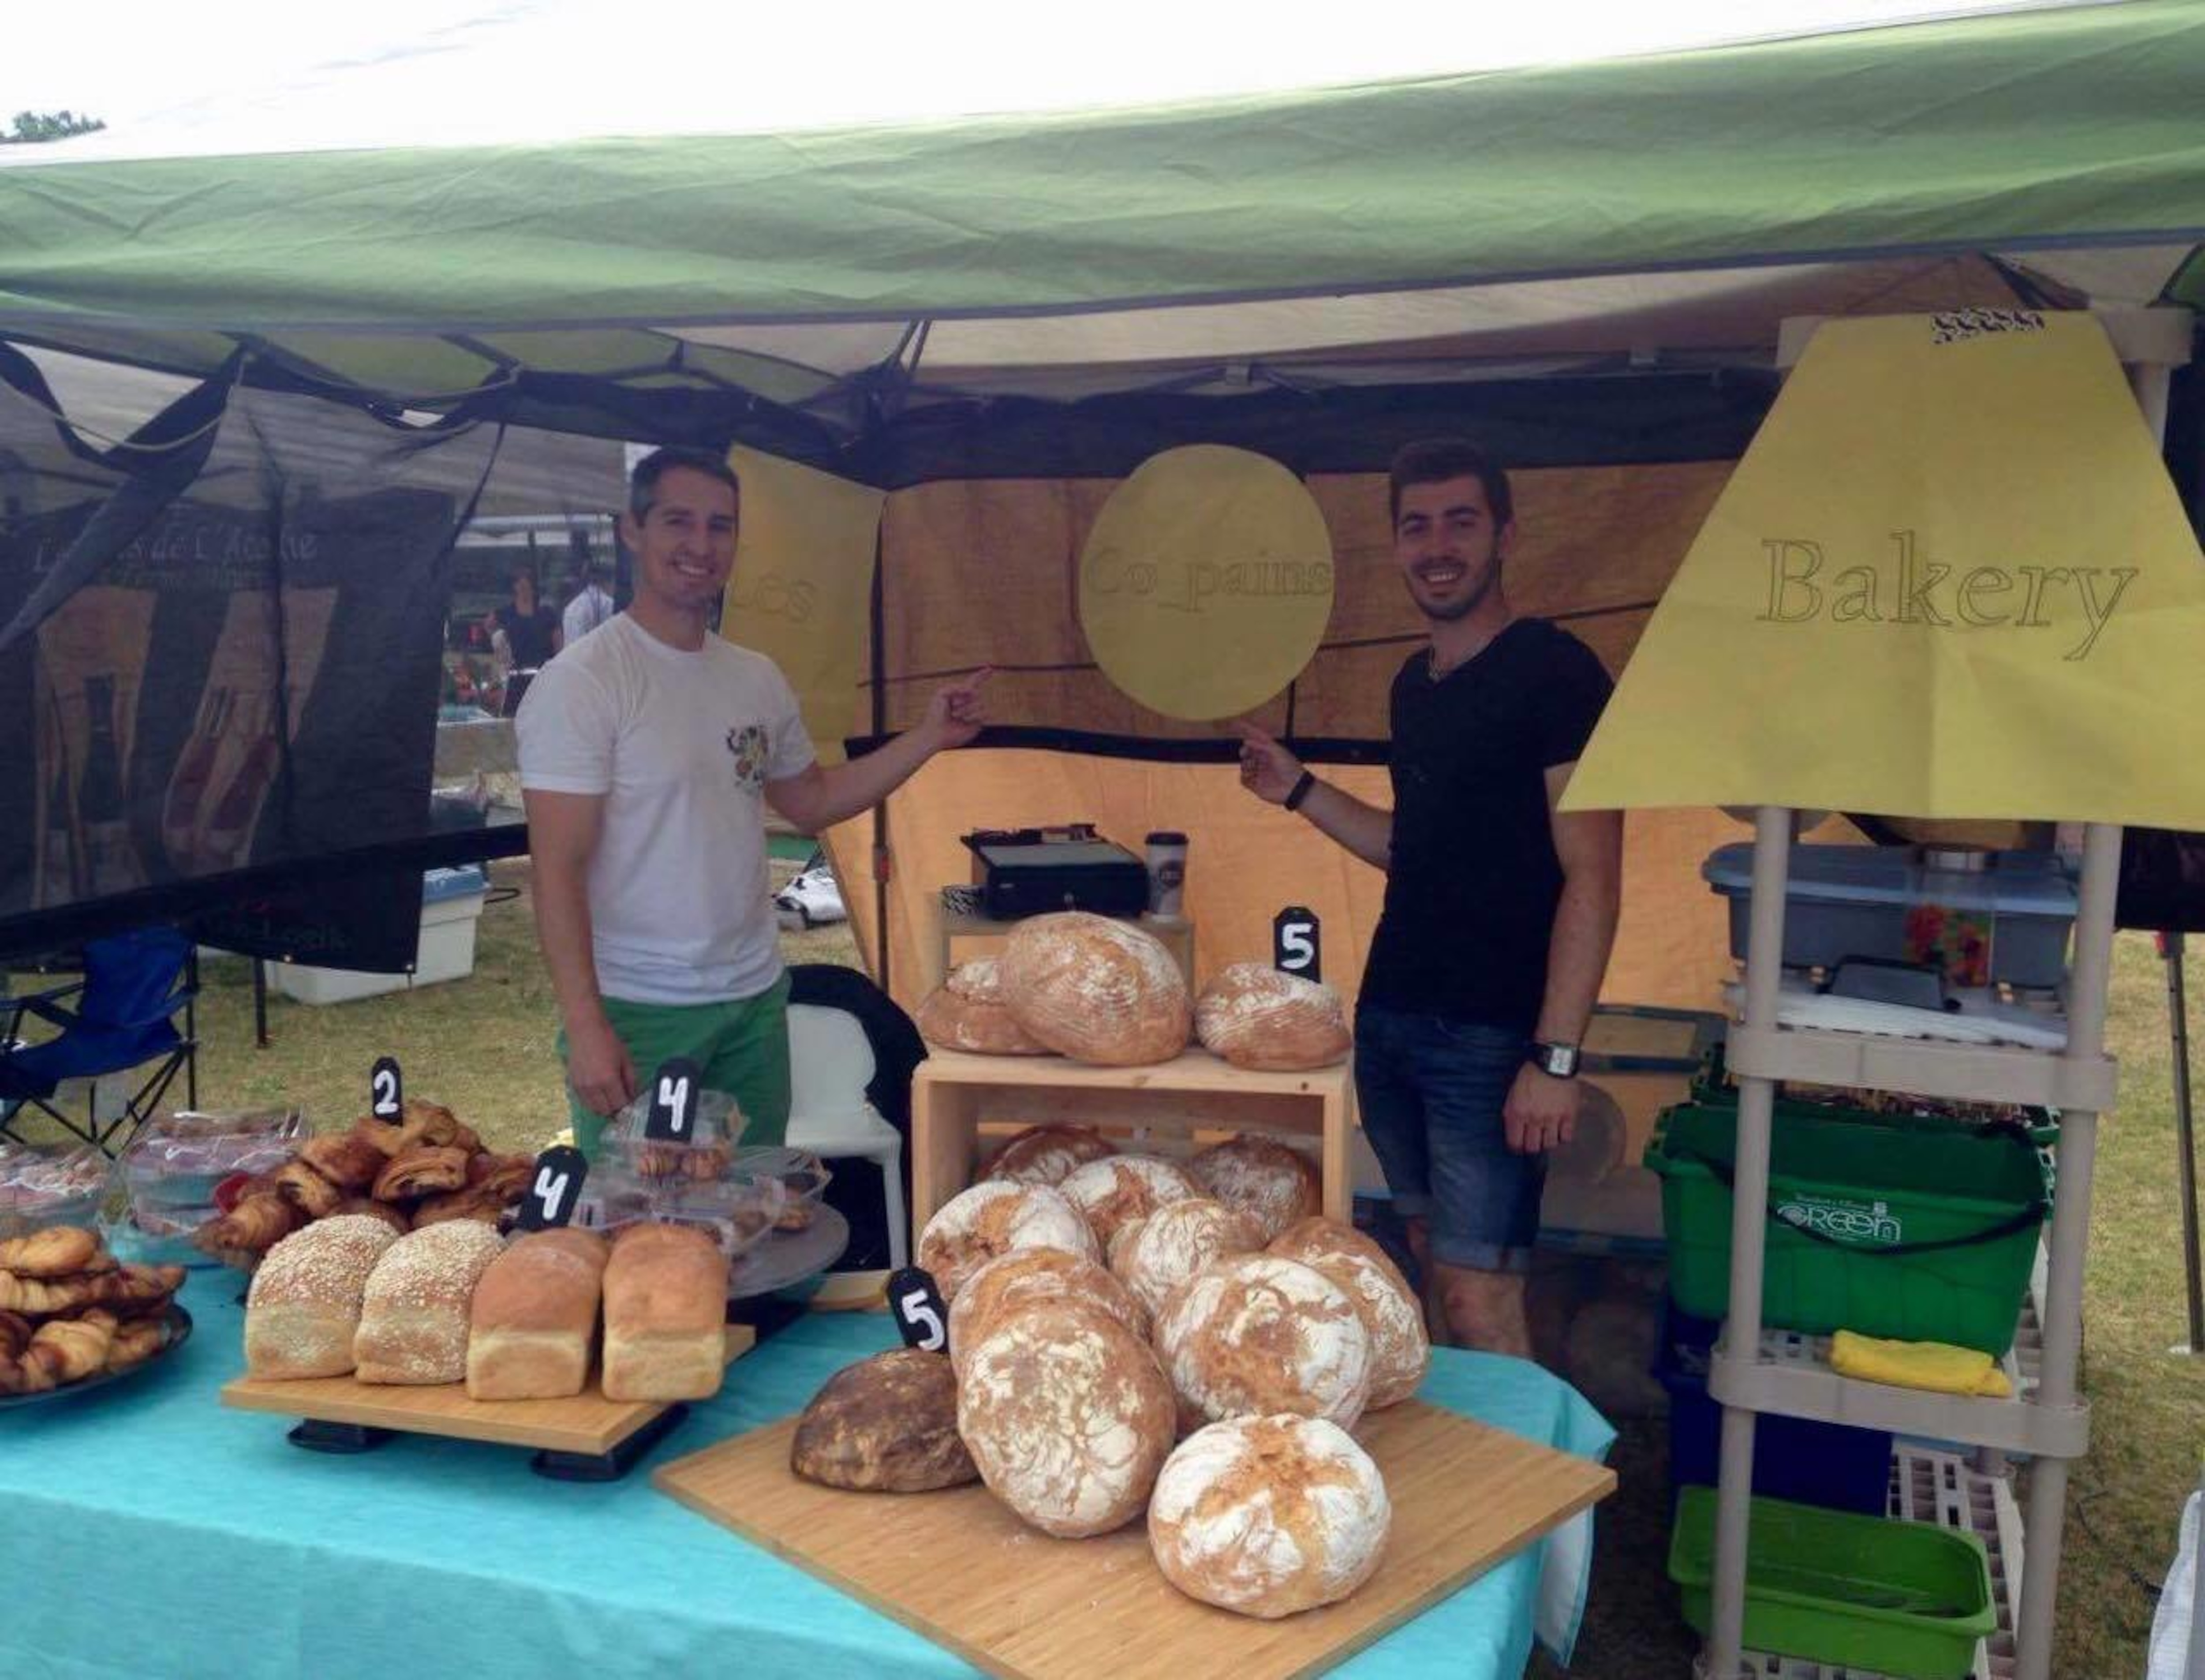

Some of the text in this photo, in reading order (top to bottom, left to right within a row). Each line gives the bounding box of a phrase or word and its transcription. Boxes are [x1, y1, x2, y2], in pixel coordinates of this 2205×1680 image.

[1755, 530, 2140, 662] Bakery
[1282, 923, 1314, 969] 5
[373, 1070, 400, 1114] 2
[658, 1077, 689, 1132] 4
[534, 1166, 569, 1220] 4
[901, 1289, 945, 1351] 5
